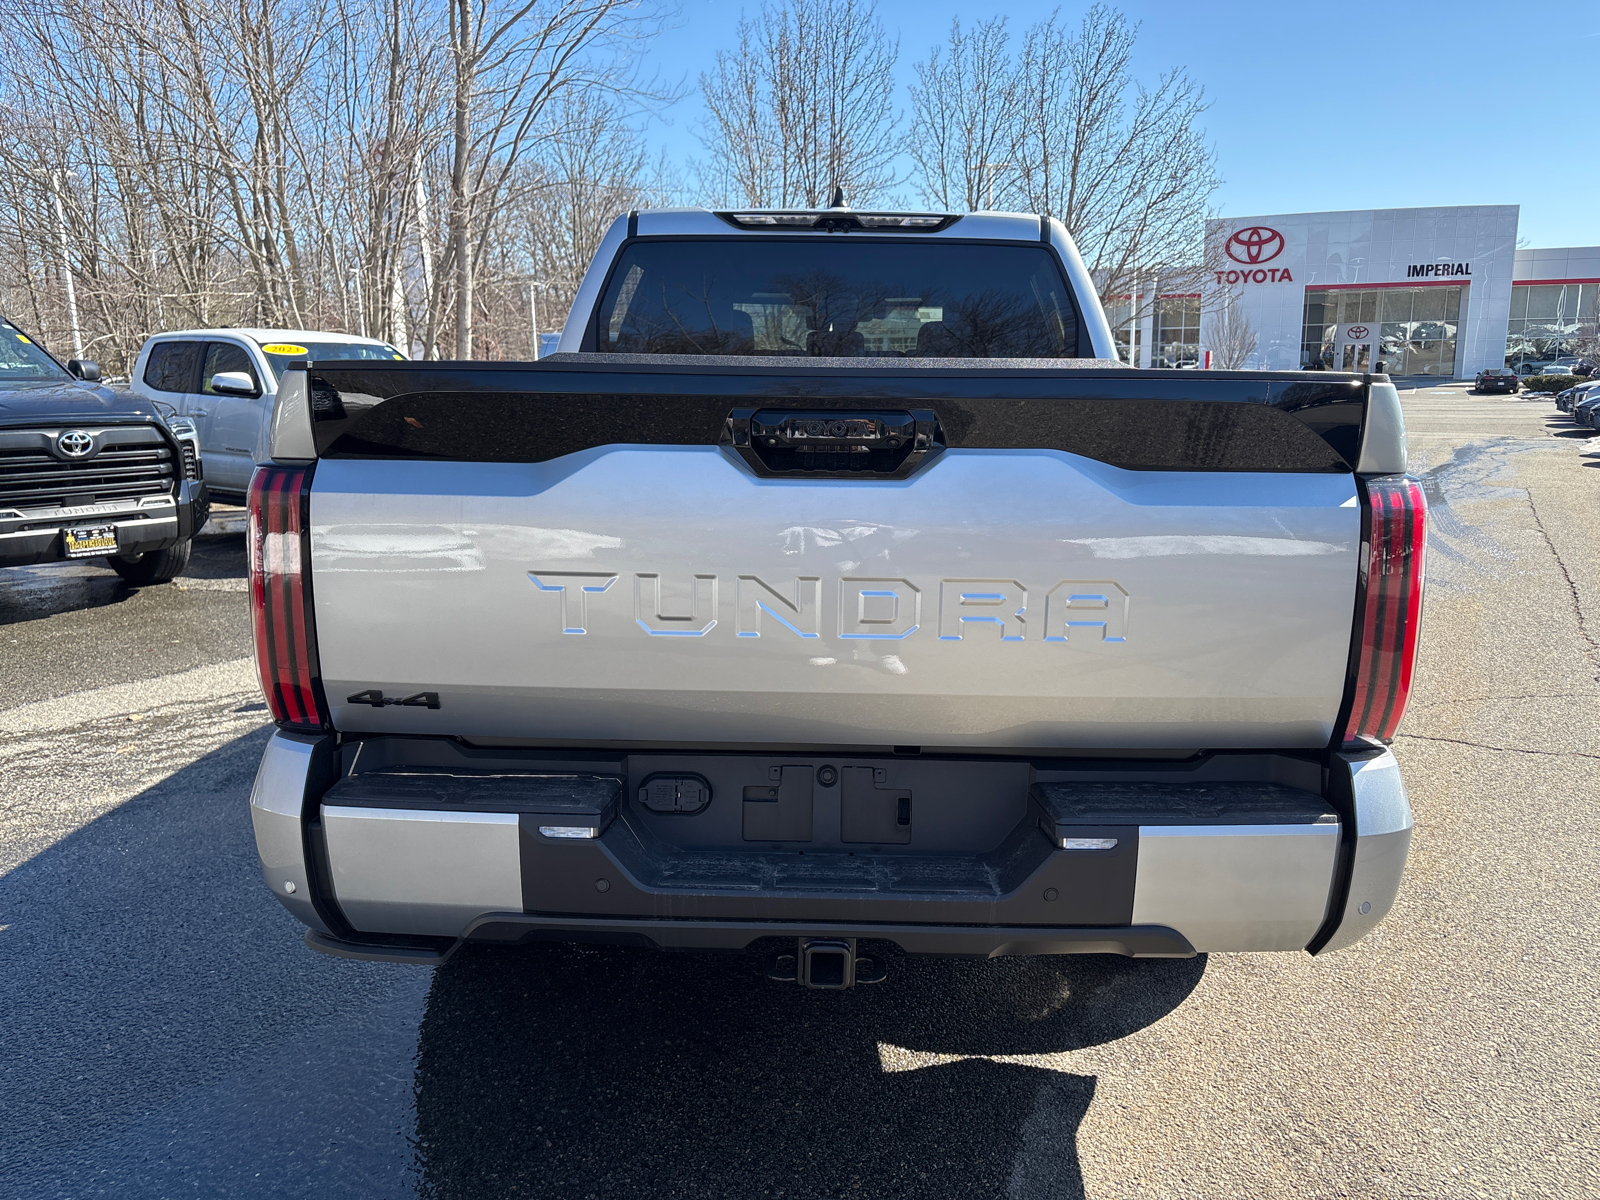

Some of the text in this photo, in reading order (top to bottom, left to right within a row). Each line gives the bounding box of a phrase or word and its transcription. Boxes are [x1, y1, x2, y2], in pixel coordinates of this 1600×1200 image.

[1214, 268, 1293, 284] TOYOTA
[1407, 263, 1472, 277] IMPERIAL
[795, 420, 871, 437] TOYOTA
[527, 571, 1130, 642] TUNDRA
